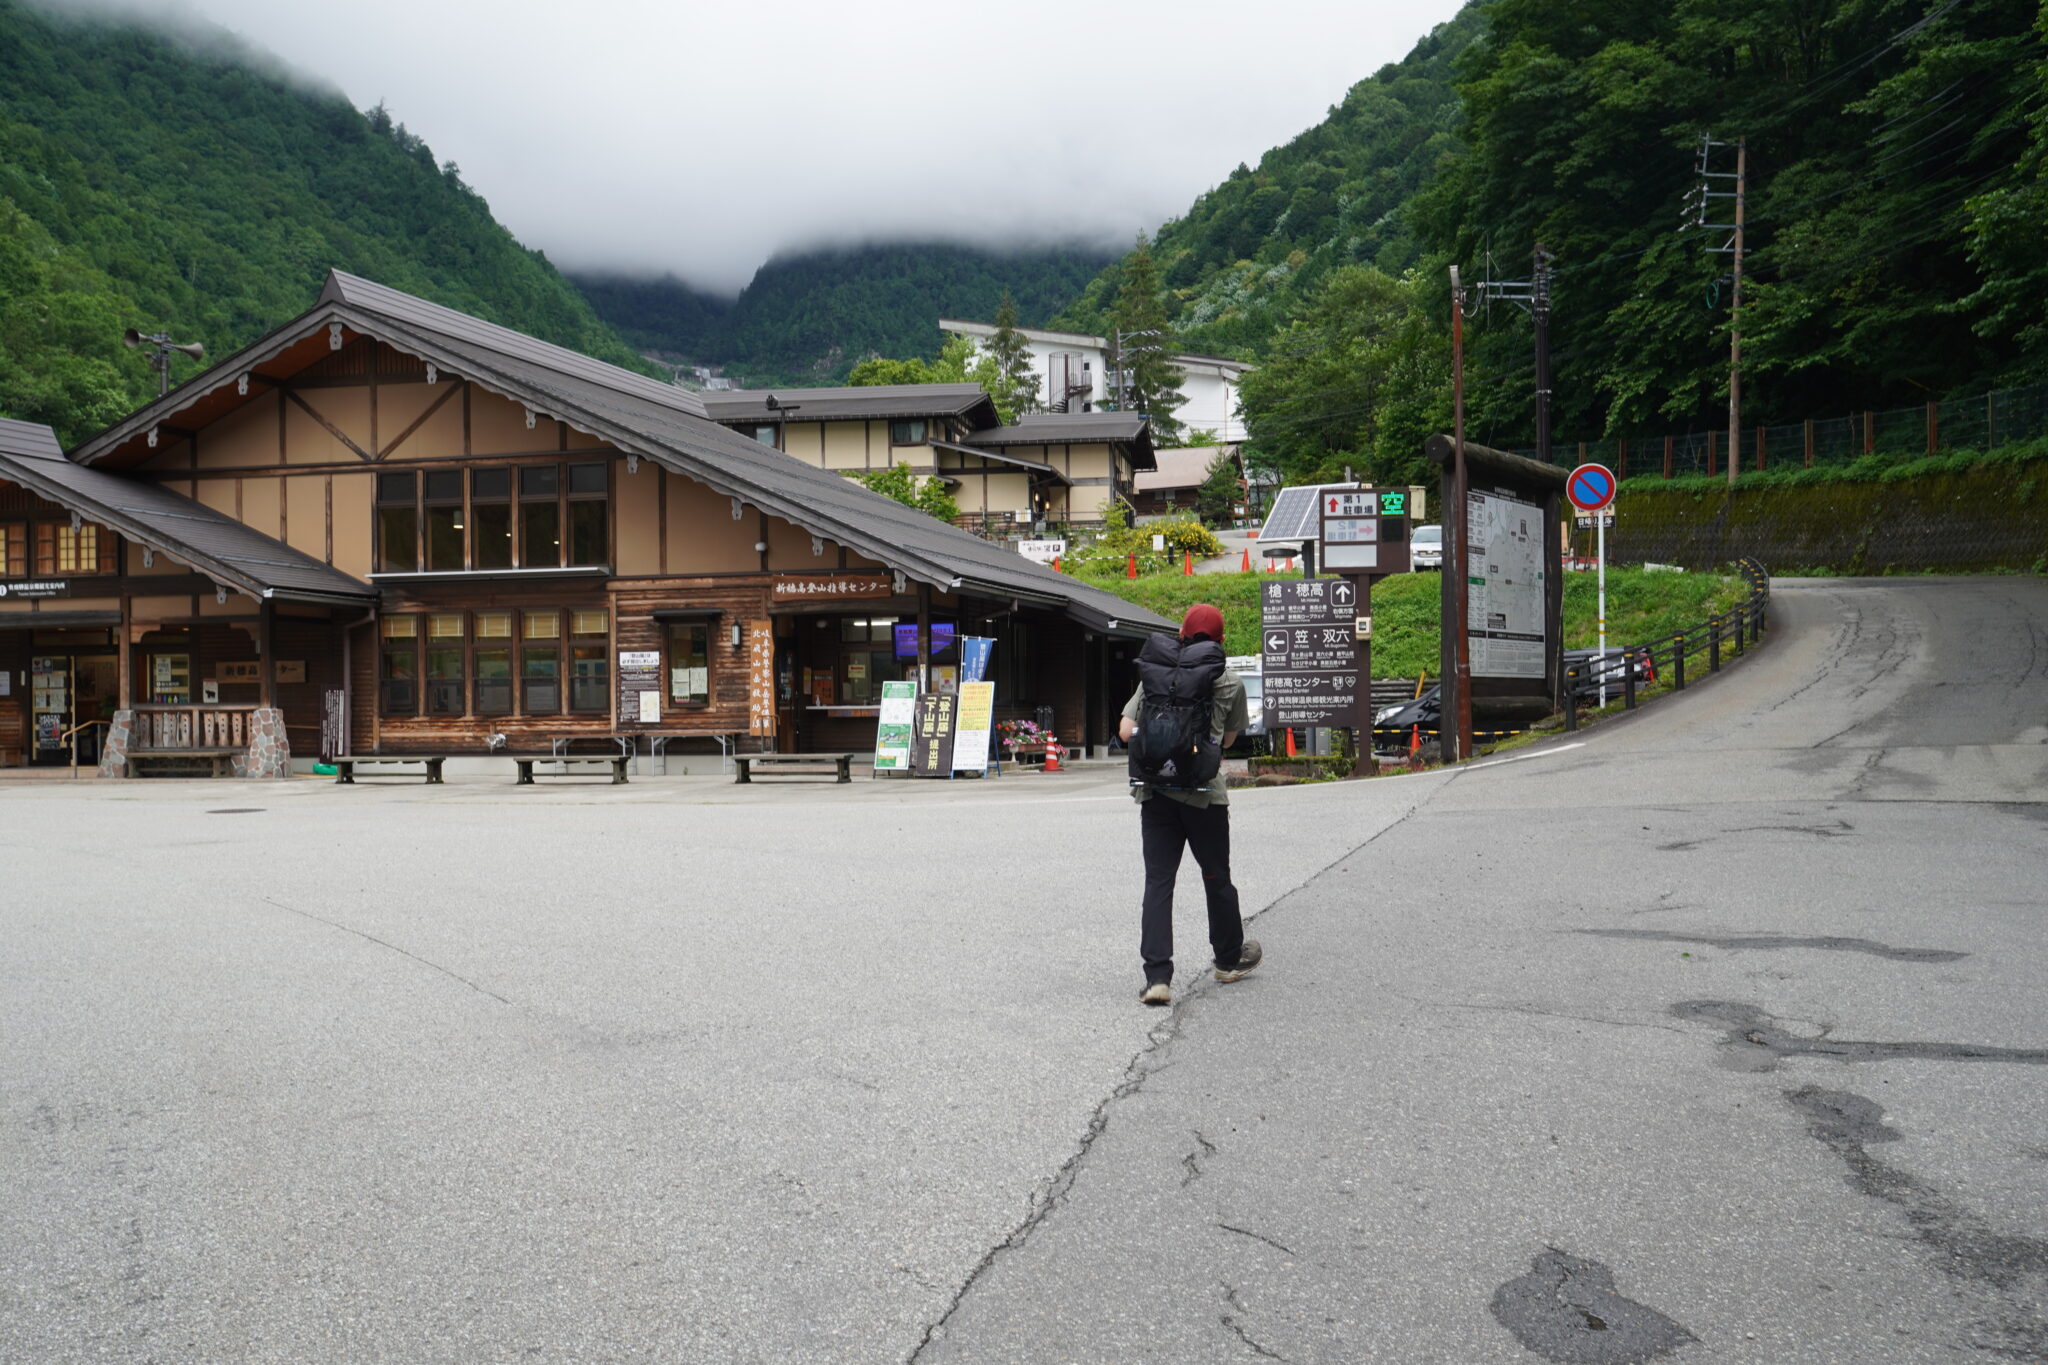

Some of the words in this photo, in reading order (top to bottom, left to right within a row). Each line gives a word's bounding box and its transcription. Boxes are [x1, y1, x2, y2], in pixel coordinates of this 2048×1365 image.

[1381, 491, 1404, 515] 空
[1344, 505, 1373, 515] 駐車場
[776, 582, 888, 594] 新穂高登山指導センター
[1265, 677, 1330, 688] 新穂高センター
[1278, 695, 1354, 704] 奥飛騨温泉郷観光案内所
[922, 696, 937, 738] 「下山届」
[936, 696, 952, 738] 「登山届」
[1278, 711, 1333, 719] 登山指導センター
[927, 739, 939, 770] 提出所
